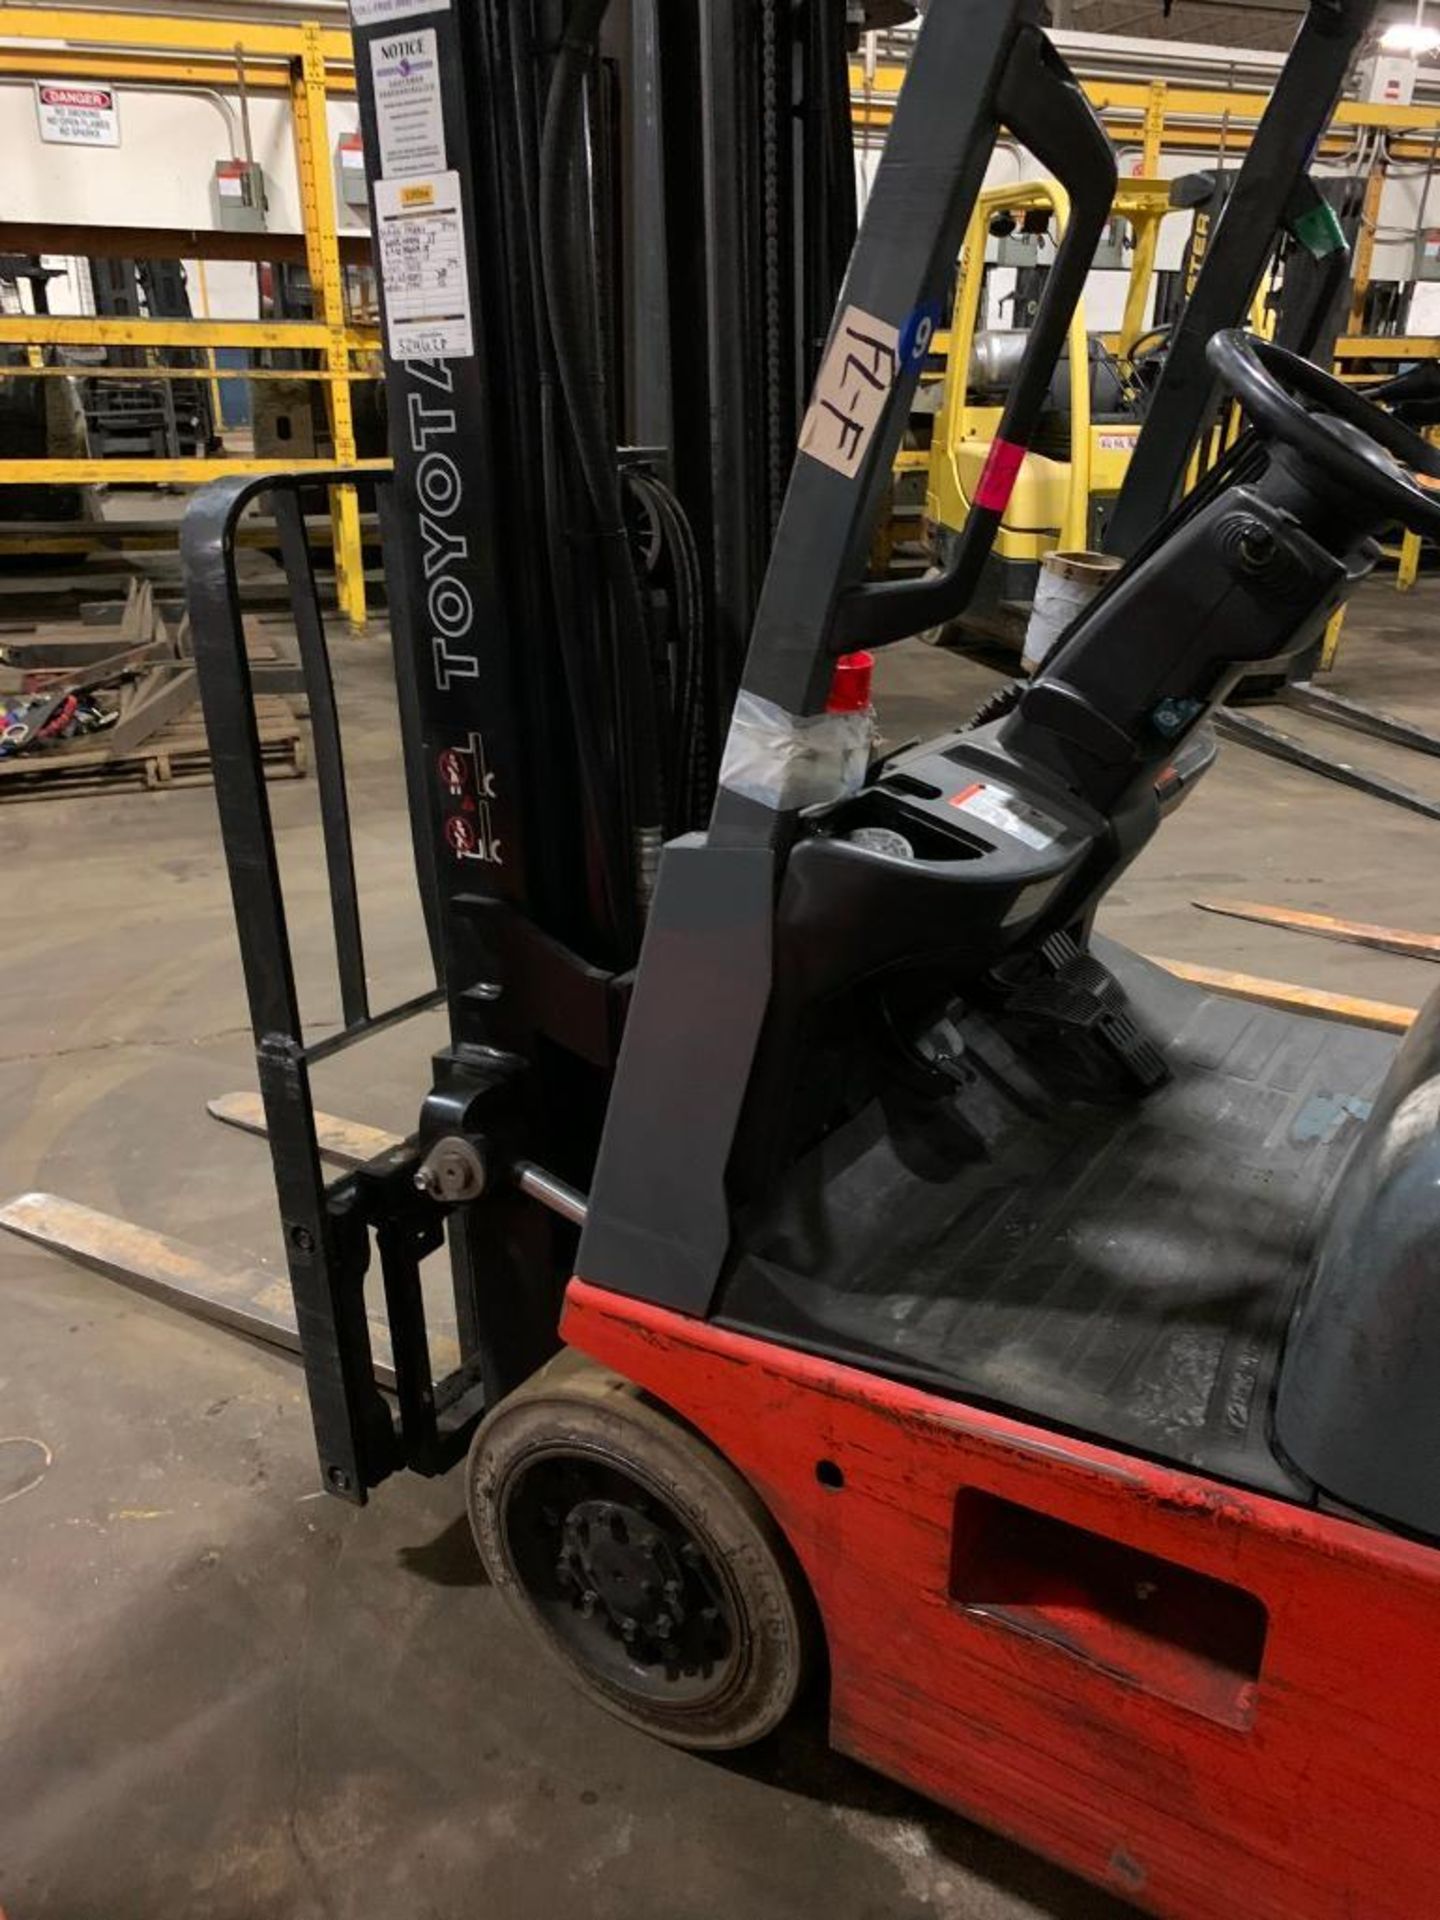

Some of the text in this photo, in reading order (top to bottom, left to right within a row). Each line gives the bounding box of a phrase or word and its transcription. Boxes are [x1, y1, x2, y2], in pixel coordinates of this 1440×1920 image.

[380, 38, 424, 59] NOTICE
[49, 89, 102, 107] DANGER
[1185, 213, 1210, 300] STER
